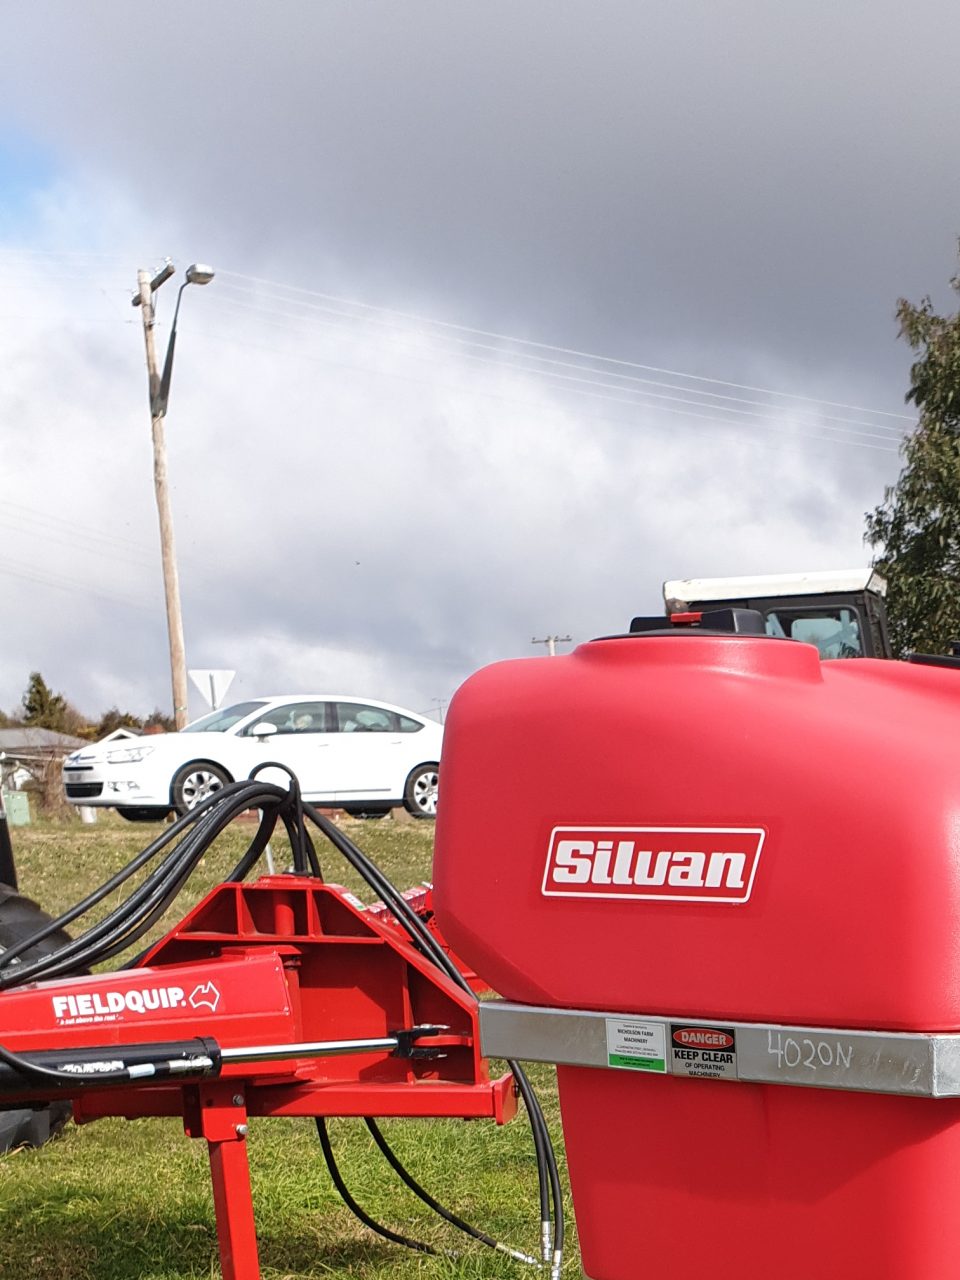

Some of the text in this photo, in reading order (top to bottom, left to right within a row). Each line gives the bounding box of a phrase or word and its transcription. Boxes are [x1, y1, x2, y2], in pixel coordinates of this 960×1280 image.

[681, 1032, 727, 1046] DANGER
[674, 1049, 734, 1064] KEEP CLEAR
[767, 1030, 853, 1070] 4020N
[688, 1070, 721, 1078] MACHINERY
[694, 1063, 725, 1071] OPERATING
